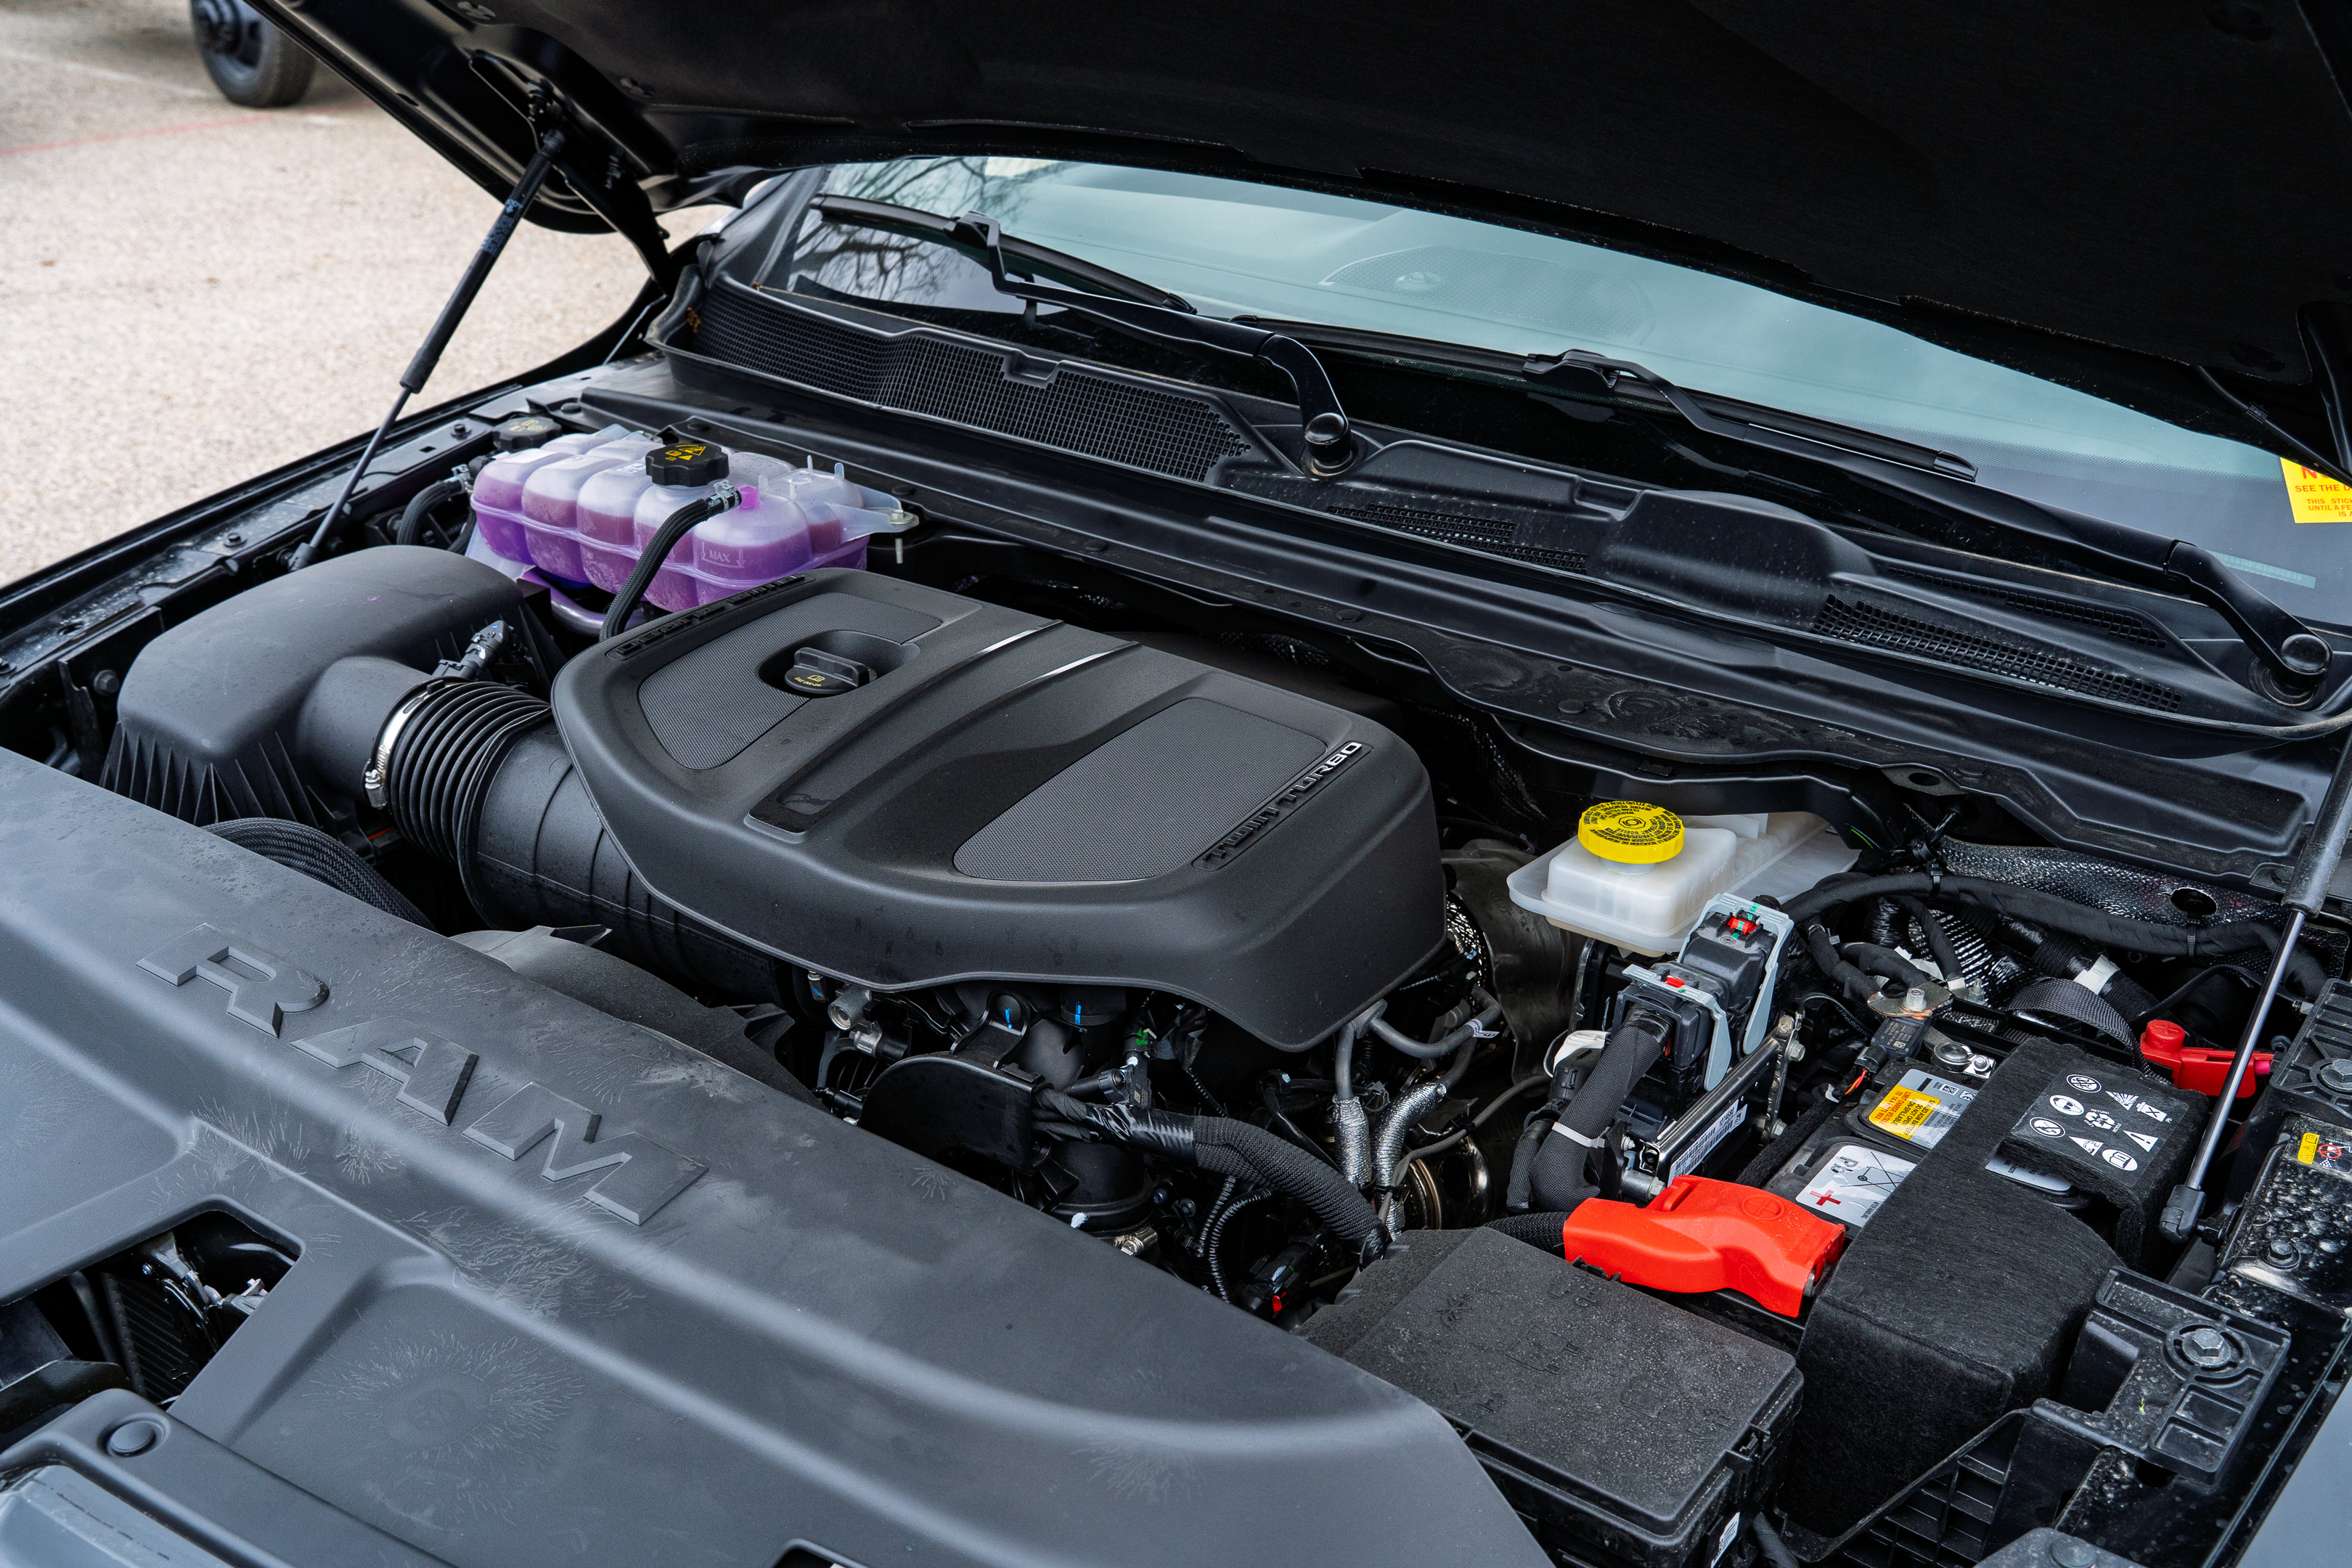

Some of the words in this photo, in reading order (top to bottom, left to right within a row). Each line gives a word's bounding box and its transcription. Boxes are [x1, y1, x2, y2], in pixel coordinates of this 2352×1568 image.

[709, 550, 730, 563] MAX
[1202, 807, 1280, 862] TWIN
[1275, 741, 1363, 807] TURBO
[134, 922, 710, 1227] RAM
[1899, 1091, 1911, 1101] LIMIT
[1890, 1099, 1904, 1112] CHARGE
[1878, 1111, 1894, 1125] VOLTAGE
[1902, 1119, 1919, 1135] BATTERY
